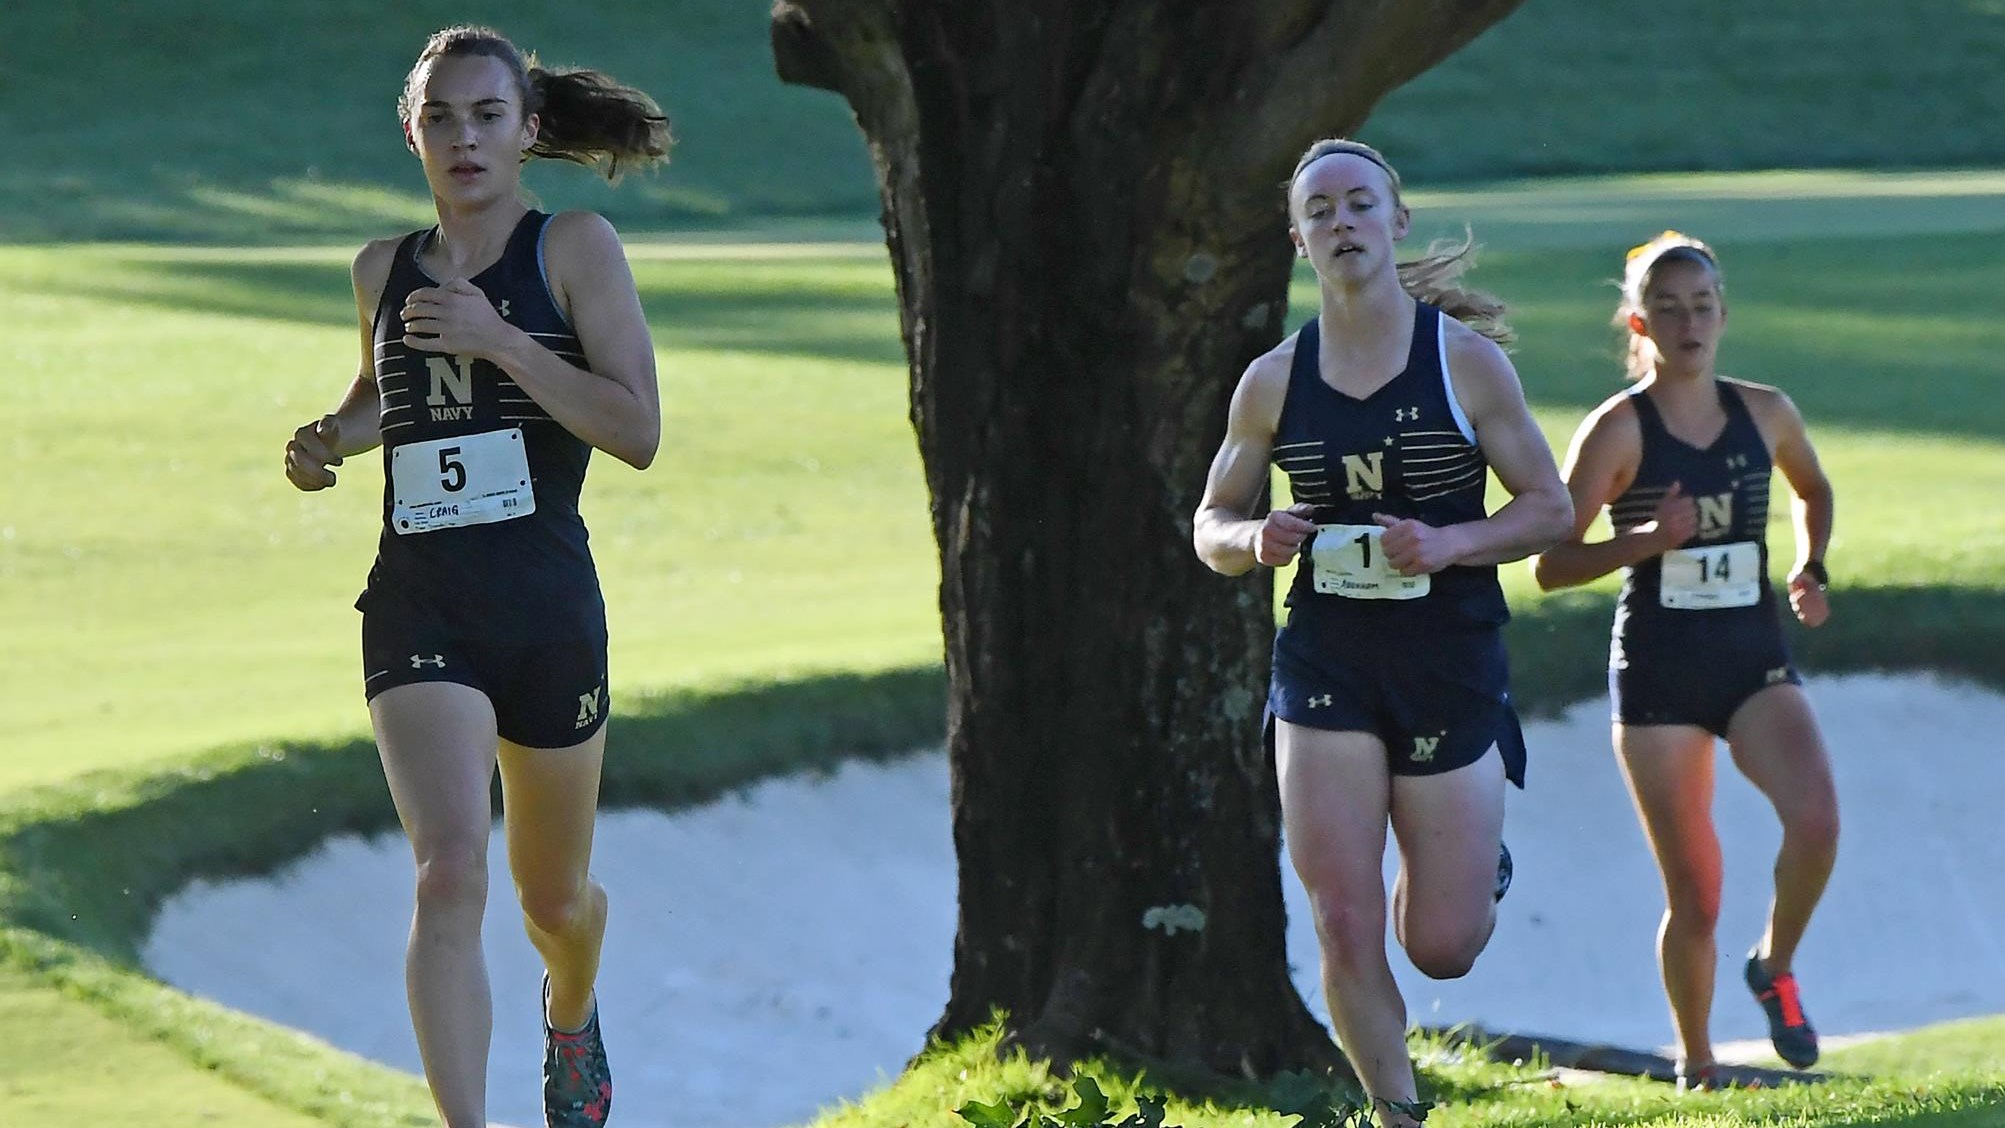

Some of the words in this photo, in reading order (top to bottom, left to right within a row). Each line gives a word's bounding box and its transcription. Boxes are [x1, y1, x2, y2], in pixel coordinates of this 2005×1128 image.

[425, 353, 474, 406] N
[430, 406, 473, 422] NAVY
[439, 446, 467, 492] 5
[1342, 452, 1384, 494] N
[430, 505, 459, 518] CRAIG
[1698, 493, 1733, 530] N
[1354, 532, 1371, 569] 1
[1697, 552, 1730, 583] 14
[577, 685, 601, 721] N
